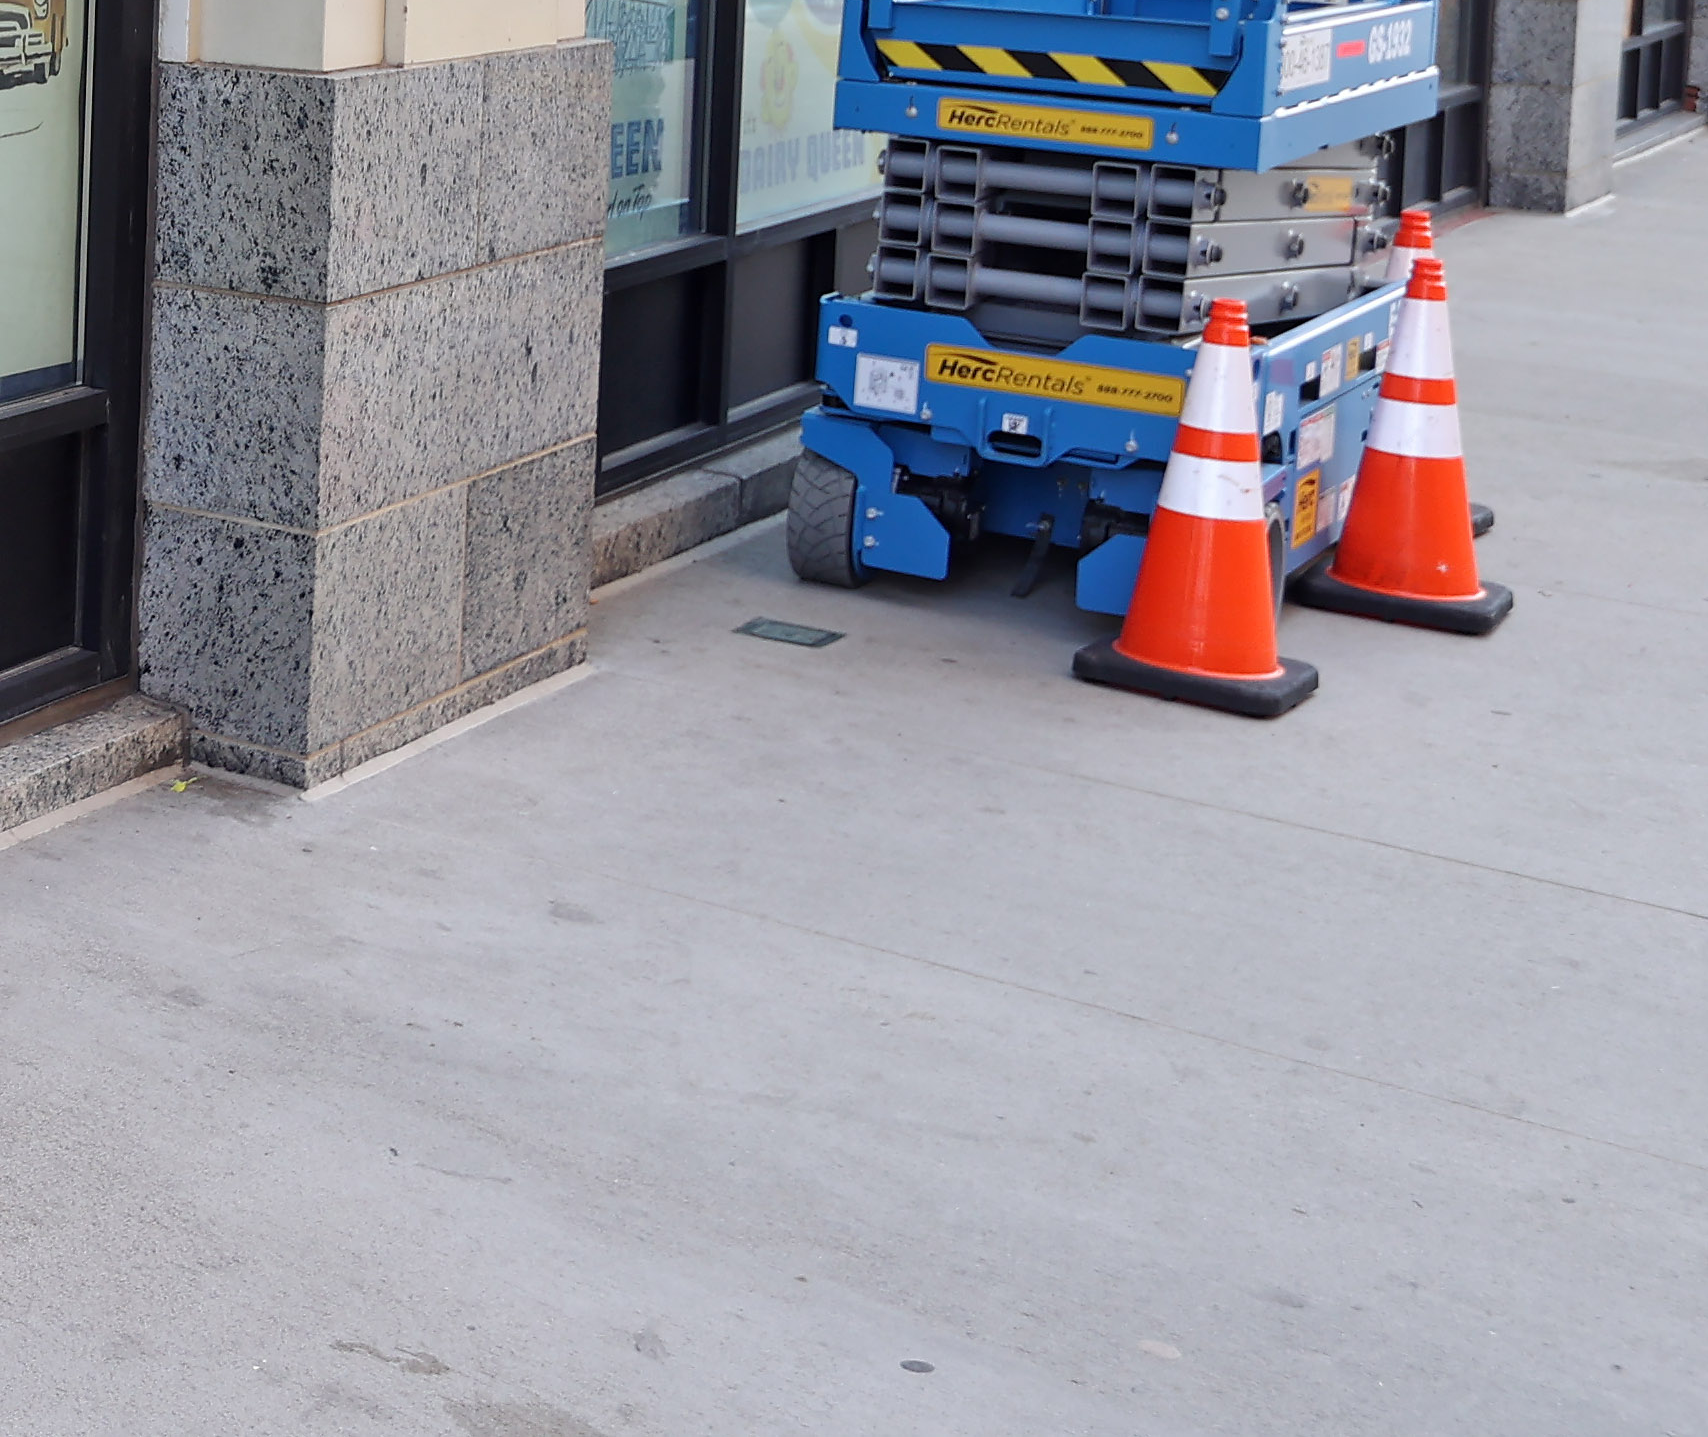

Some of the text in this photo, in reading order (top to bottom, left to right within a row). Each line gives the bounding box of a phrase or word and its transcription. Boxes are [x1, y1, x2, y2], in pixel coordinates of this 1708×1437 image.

[1367, 19, 1413, 64] GS-1932
[611, 118, 664, 179] EEN
[739, 129, 865, 195] DAIRY QUEEN
